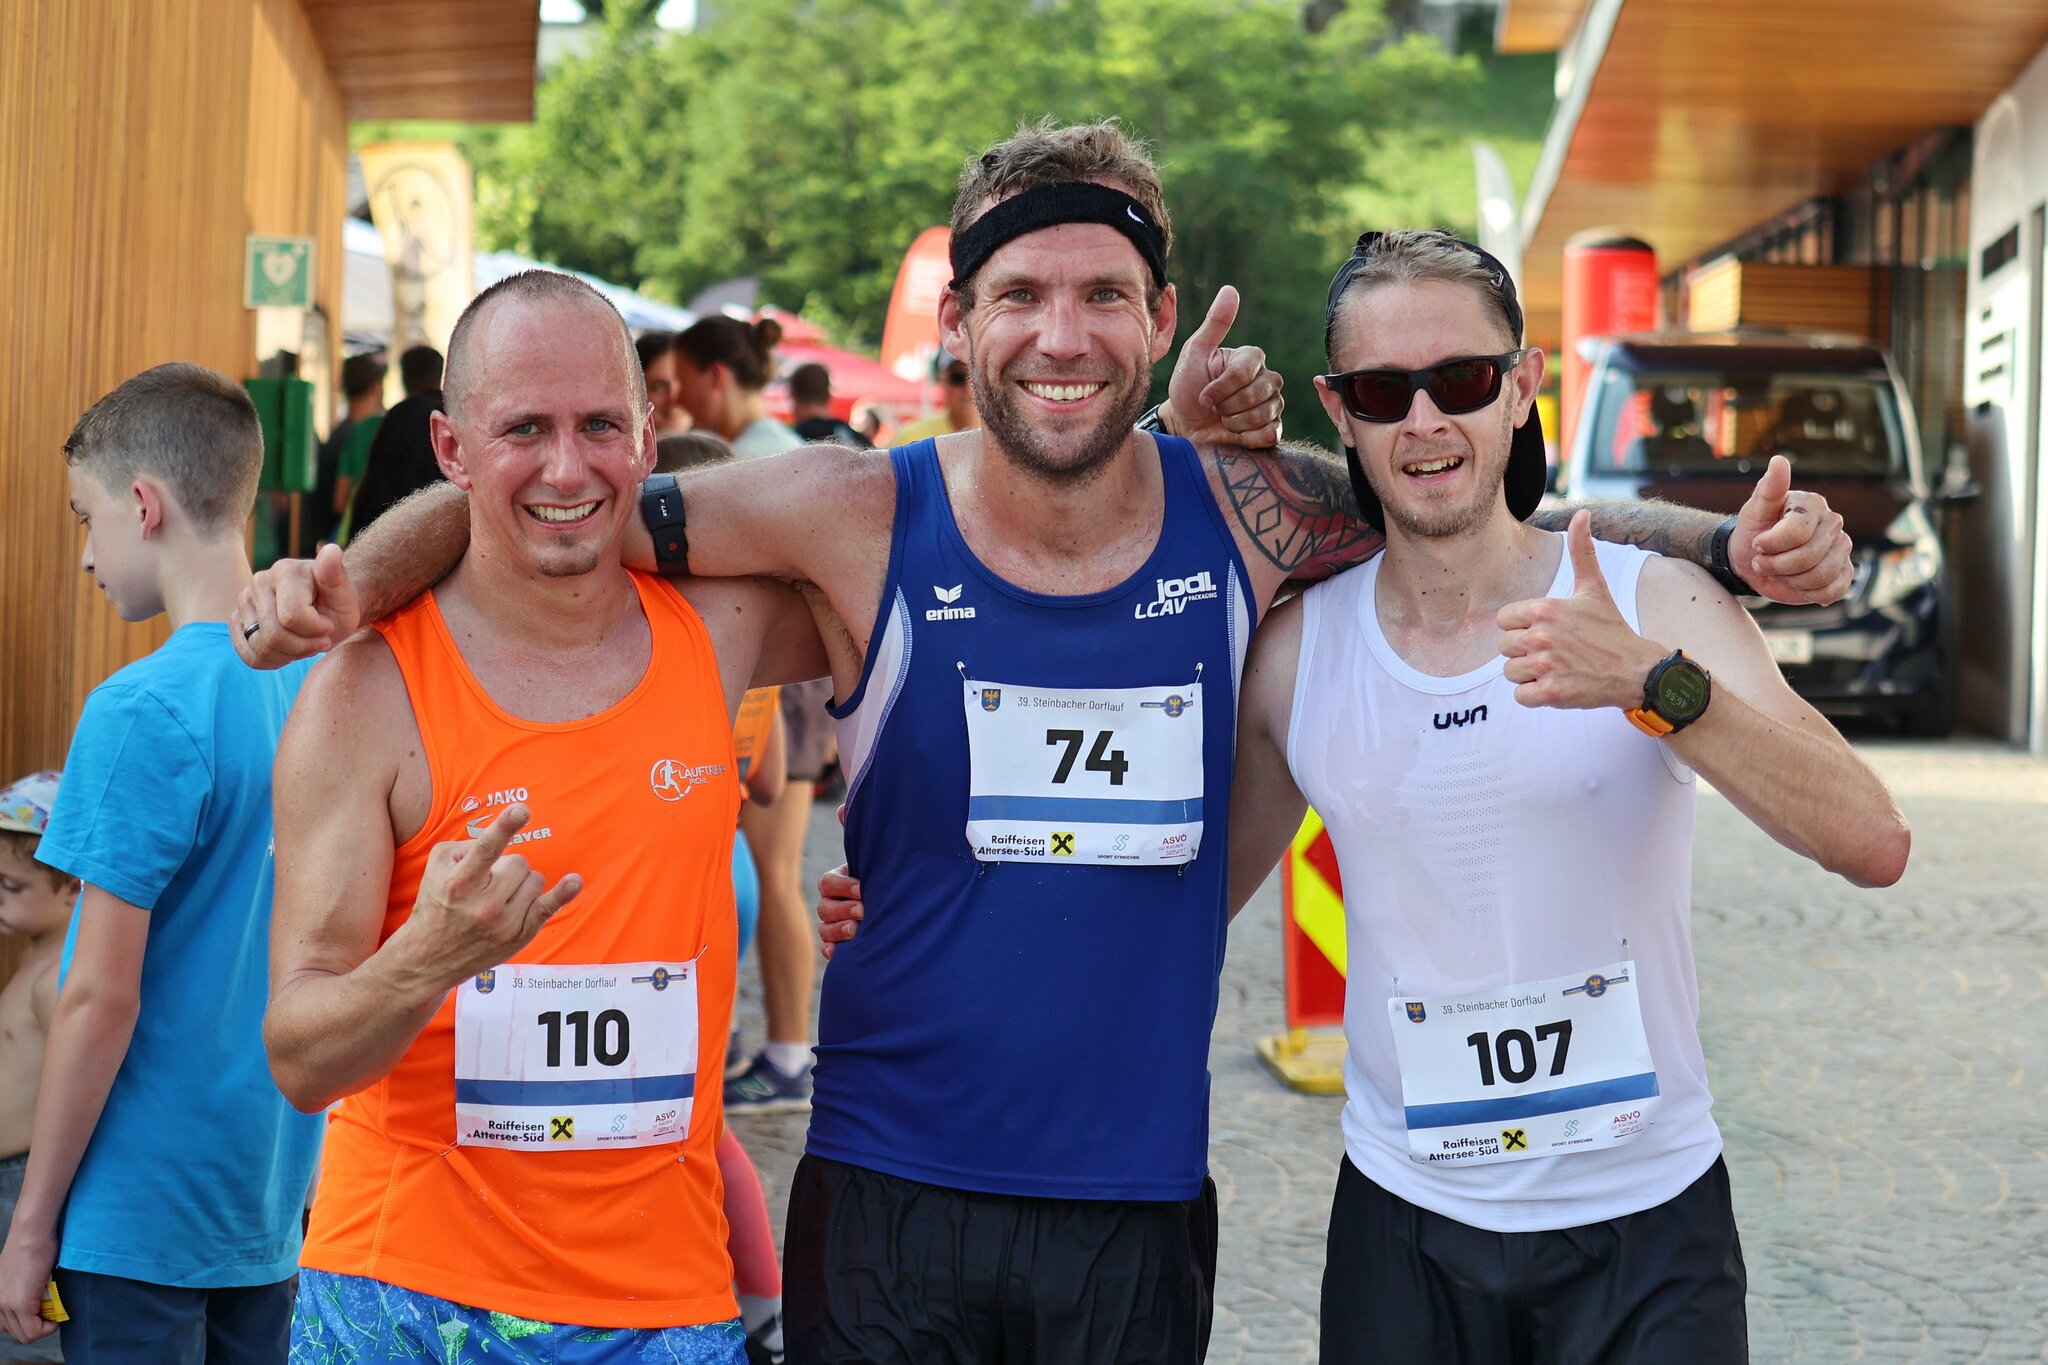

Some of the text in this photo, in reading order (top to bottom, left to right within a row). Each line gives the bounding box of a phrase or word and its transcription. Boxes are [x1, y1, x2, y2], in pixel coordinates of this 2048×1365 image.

[660, 498, 668, 517] PLAR
[1188, 592, 1218, 601] PACKAGING
[925, 606, 976, 621] erima
[1134, 597, 1188, 620] LCAV
[1017, 696, 1124, 712] 39. Steinbacher Dorflauf
[1046, 729, 1128, 785] 74
[486, 787, 528, 807] JAKO
[991, 834, 1045, 846] Raiffeisen
[977, 846, 1045, 857] Attersee-Süd
[512, 976, 617, 989] 39. Steinbacher Dorflauf
[1442, 993, 1546, 1015] 39. Steinbacher Dorflauf
[537, 1008, 630, 1067] 110
[1467, 1019, 1572, 1086] 107
[488, 1120, 545, 1132] Raiffeisen
[472, 1130, 545, 1143] Attersee-Süd
[1442, 1135, 1498, 1150] Raiffeisen
[1428, 1145, 1500, 1162] Attersee-Süd
